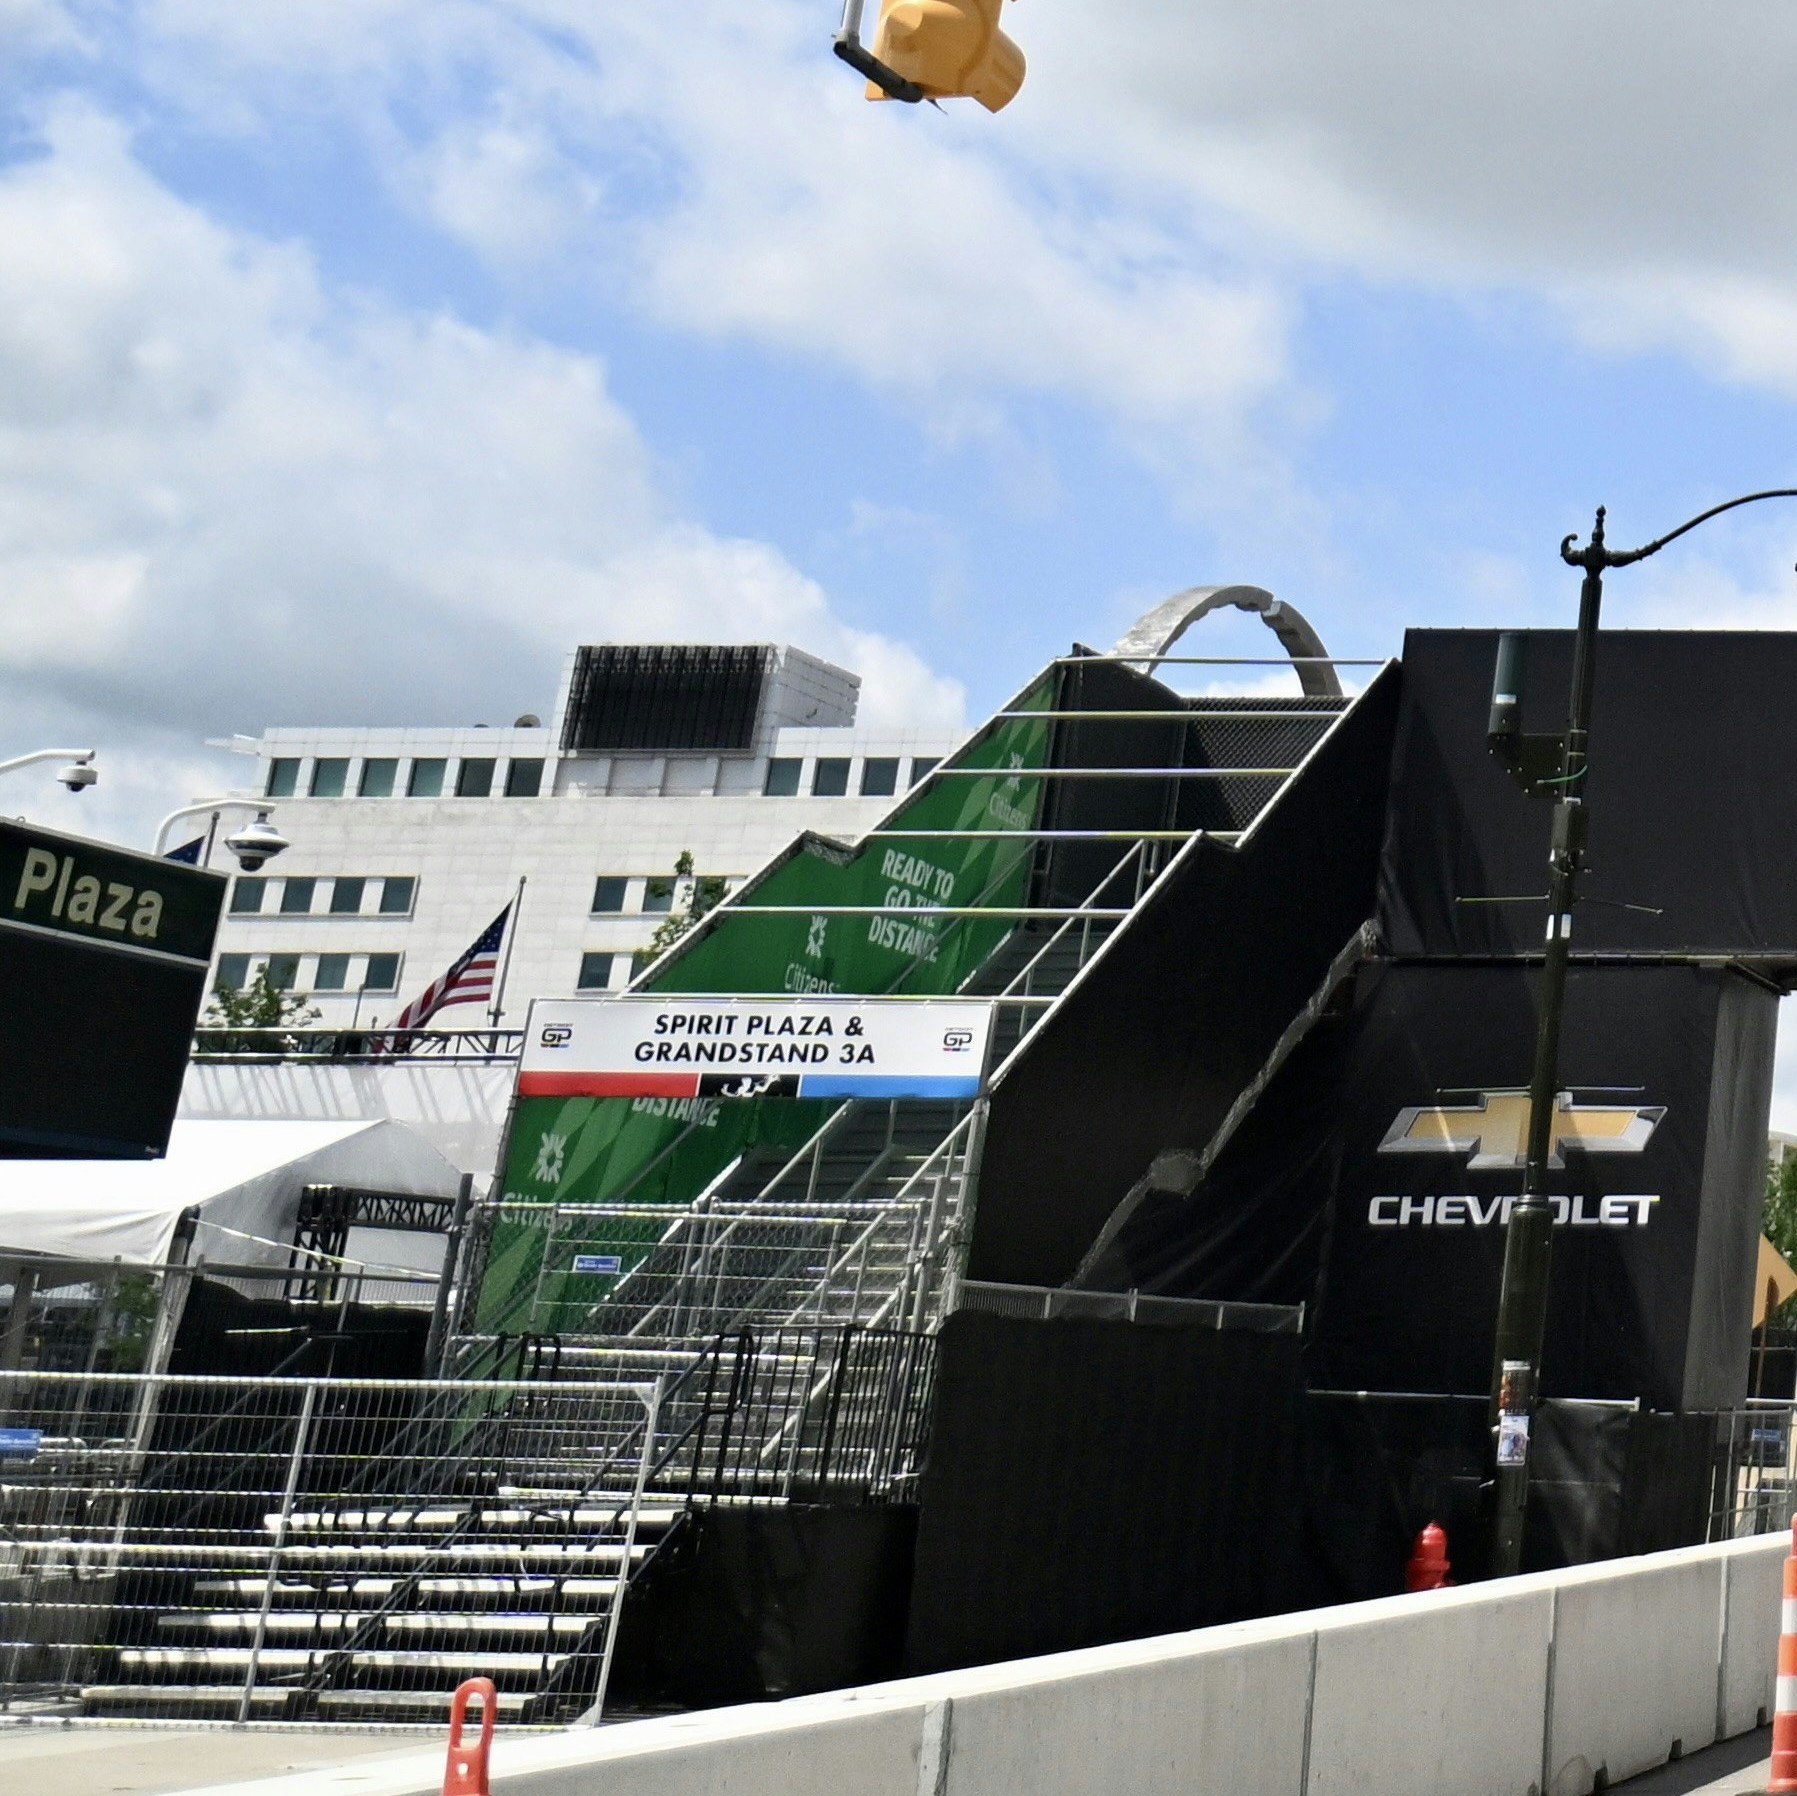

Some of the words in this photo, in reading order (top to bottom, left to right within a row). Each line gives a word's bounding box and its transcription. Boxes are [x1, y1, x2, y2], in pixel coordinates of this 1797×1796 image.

[881, 848, 935, 891] READY
[933, 868, 955, 899] TO
[14, 846, 164, 939] Plaza
[883, 885, 912, 908] GO
[654, 1014, 738, 1035] SPIRIT
[746, 1015, 834, 1036] PLAZA
[844, 1016, 865, 1037] &
[634, 1041, 830, 1063] GRANDSTAND
[839, 1042, 876, 1064] 3A
